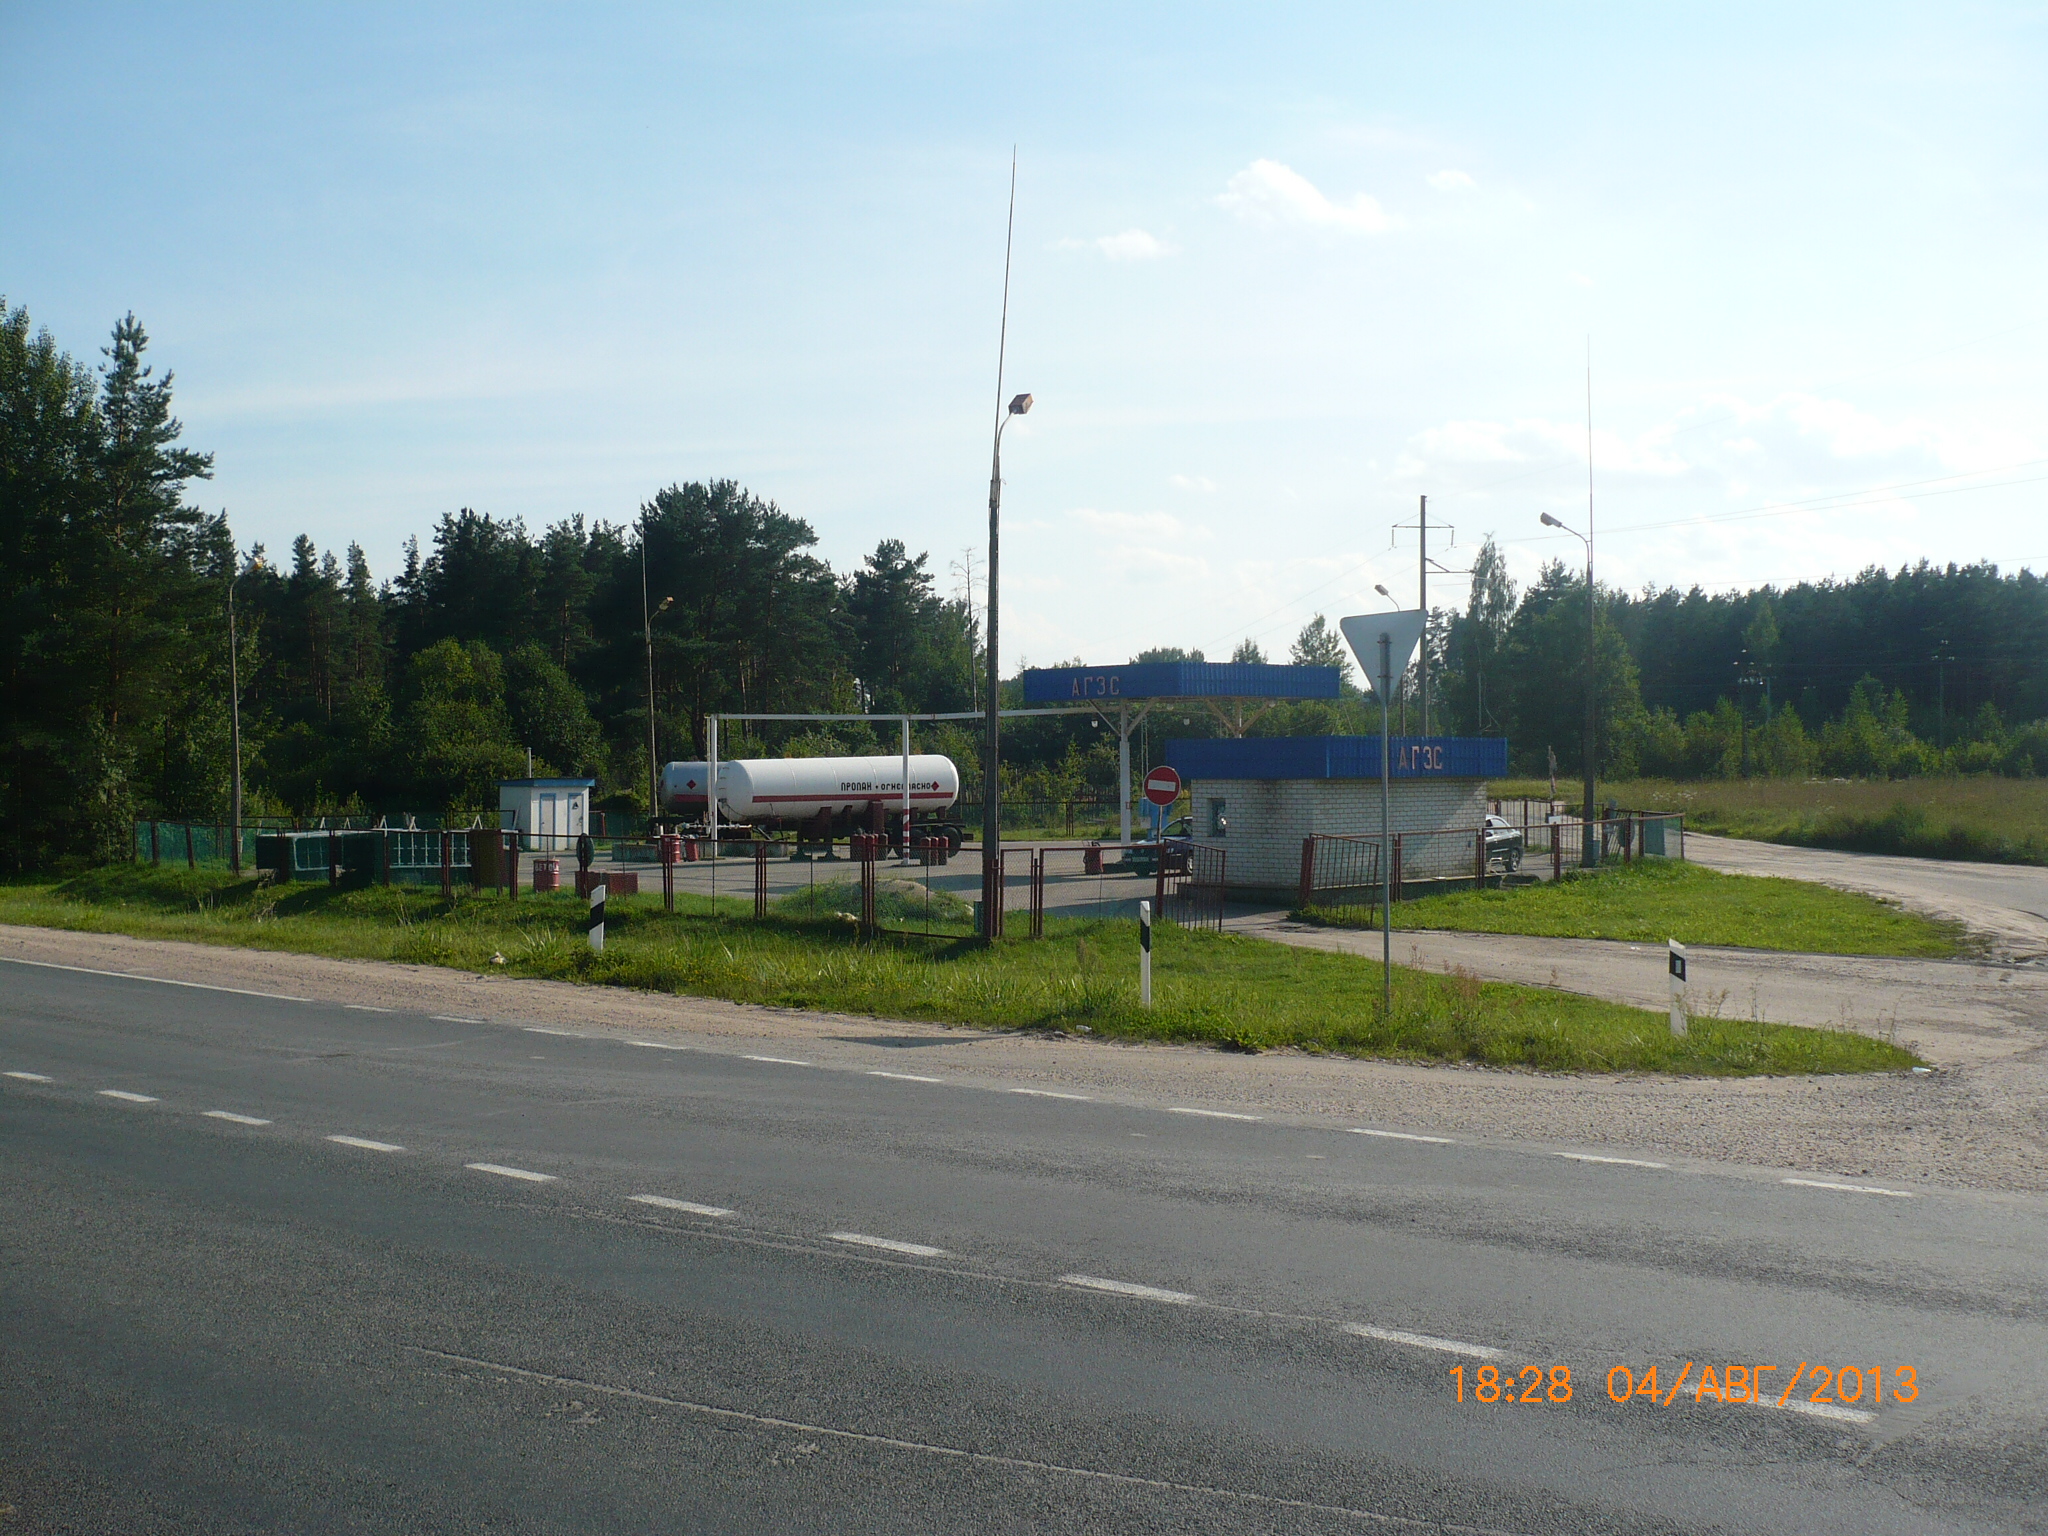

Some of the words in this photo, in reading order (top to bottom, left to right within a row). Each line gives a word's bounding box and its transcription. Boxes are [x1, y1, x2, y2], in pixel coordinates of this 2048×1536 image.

[1072, 676, 1120, 697] АГЗС
[1398, 745, 1443, 770] АГЗС
[840, 781, 872, 792] ПРОПАН
